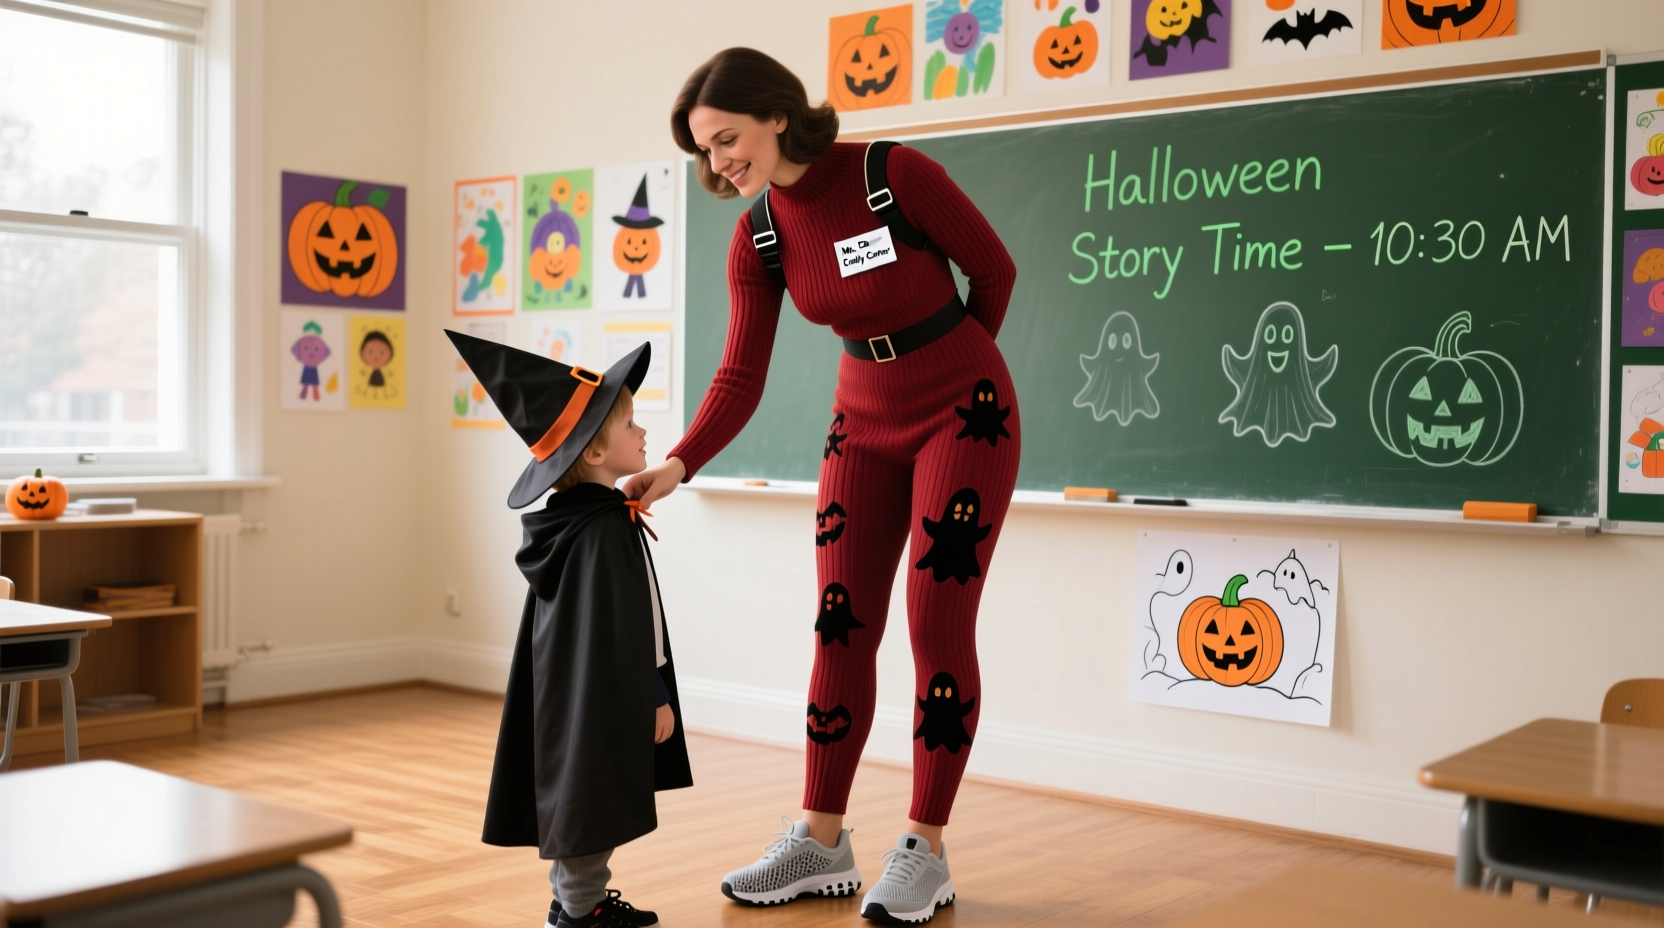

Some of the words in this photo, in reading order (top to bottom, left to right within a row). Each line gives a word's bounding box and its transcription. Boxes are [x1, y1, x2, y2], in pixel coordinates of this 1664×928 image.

[1084, 144, 1322, 212] Halloween
[1067, 231, 1184, 300] Story
[1200, 221, 1303, 275] Time
[1370, 220, 1486, 267] 10:30
[1501, 214, 1571, 264] AM
